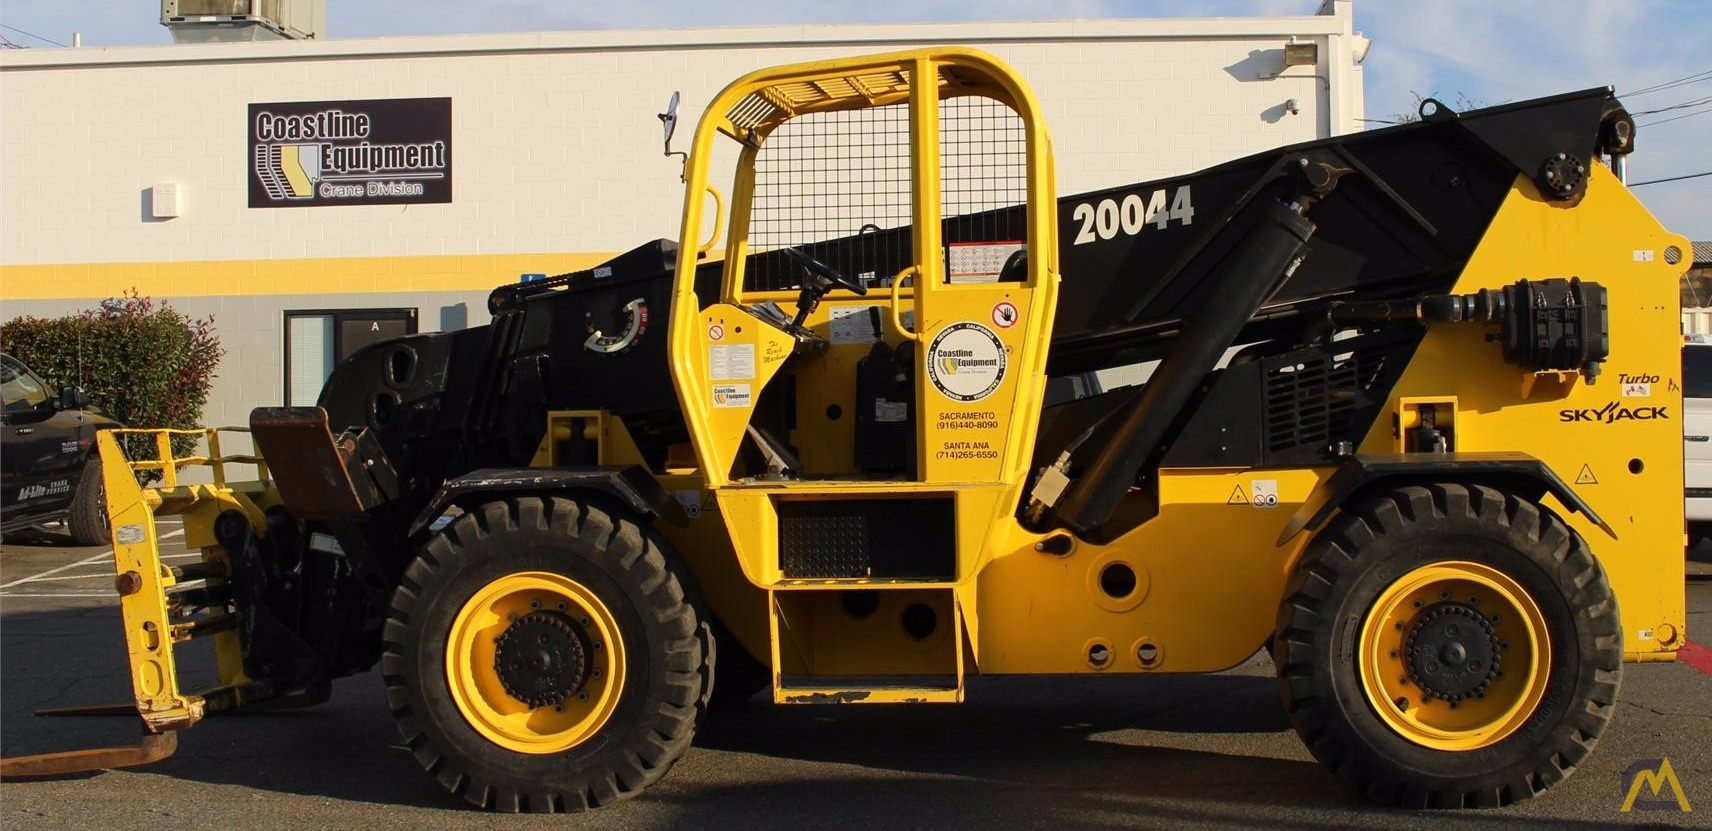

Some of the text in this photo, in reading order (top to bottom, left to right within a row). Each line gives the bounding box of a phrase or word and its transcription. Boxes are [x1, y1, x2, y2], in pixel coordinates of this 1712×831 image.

[257, 111, 369, 140] Coastline
[321, 141, 445, 172] Equipment
[320, 181, 423, 197] Crane Division
[1073, 185, 1195, 246] 20044
[371, 321, 380, 331] A
[966, 324, 995, 340] CALIFORNIA
[937, 349, 973, 358] Coastline
[957, 358, 997, 367] Equipment
[1618, 373, 1660, 384] Turbo
[939, 412, 995, 420] SACRAMENTO
[1559, 401, 1669, 424] SKYJACK
[936, 421, 998, 430] (916)440-8090
[944, 442, 970, 450] SANTA
[936, 451, 998, 460] (714)265-6550
